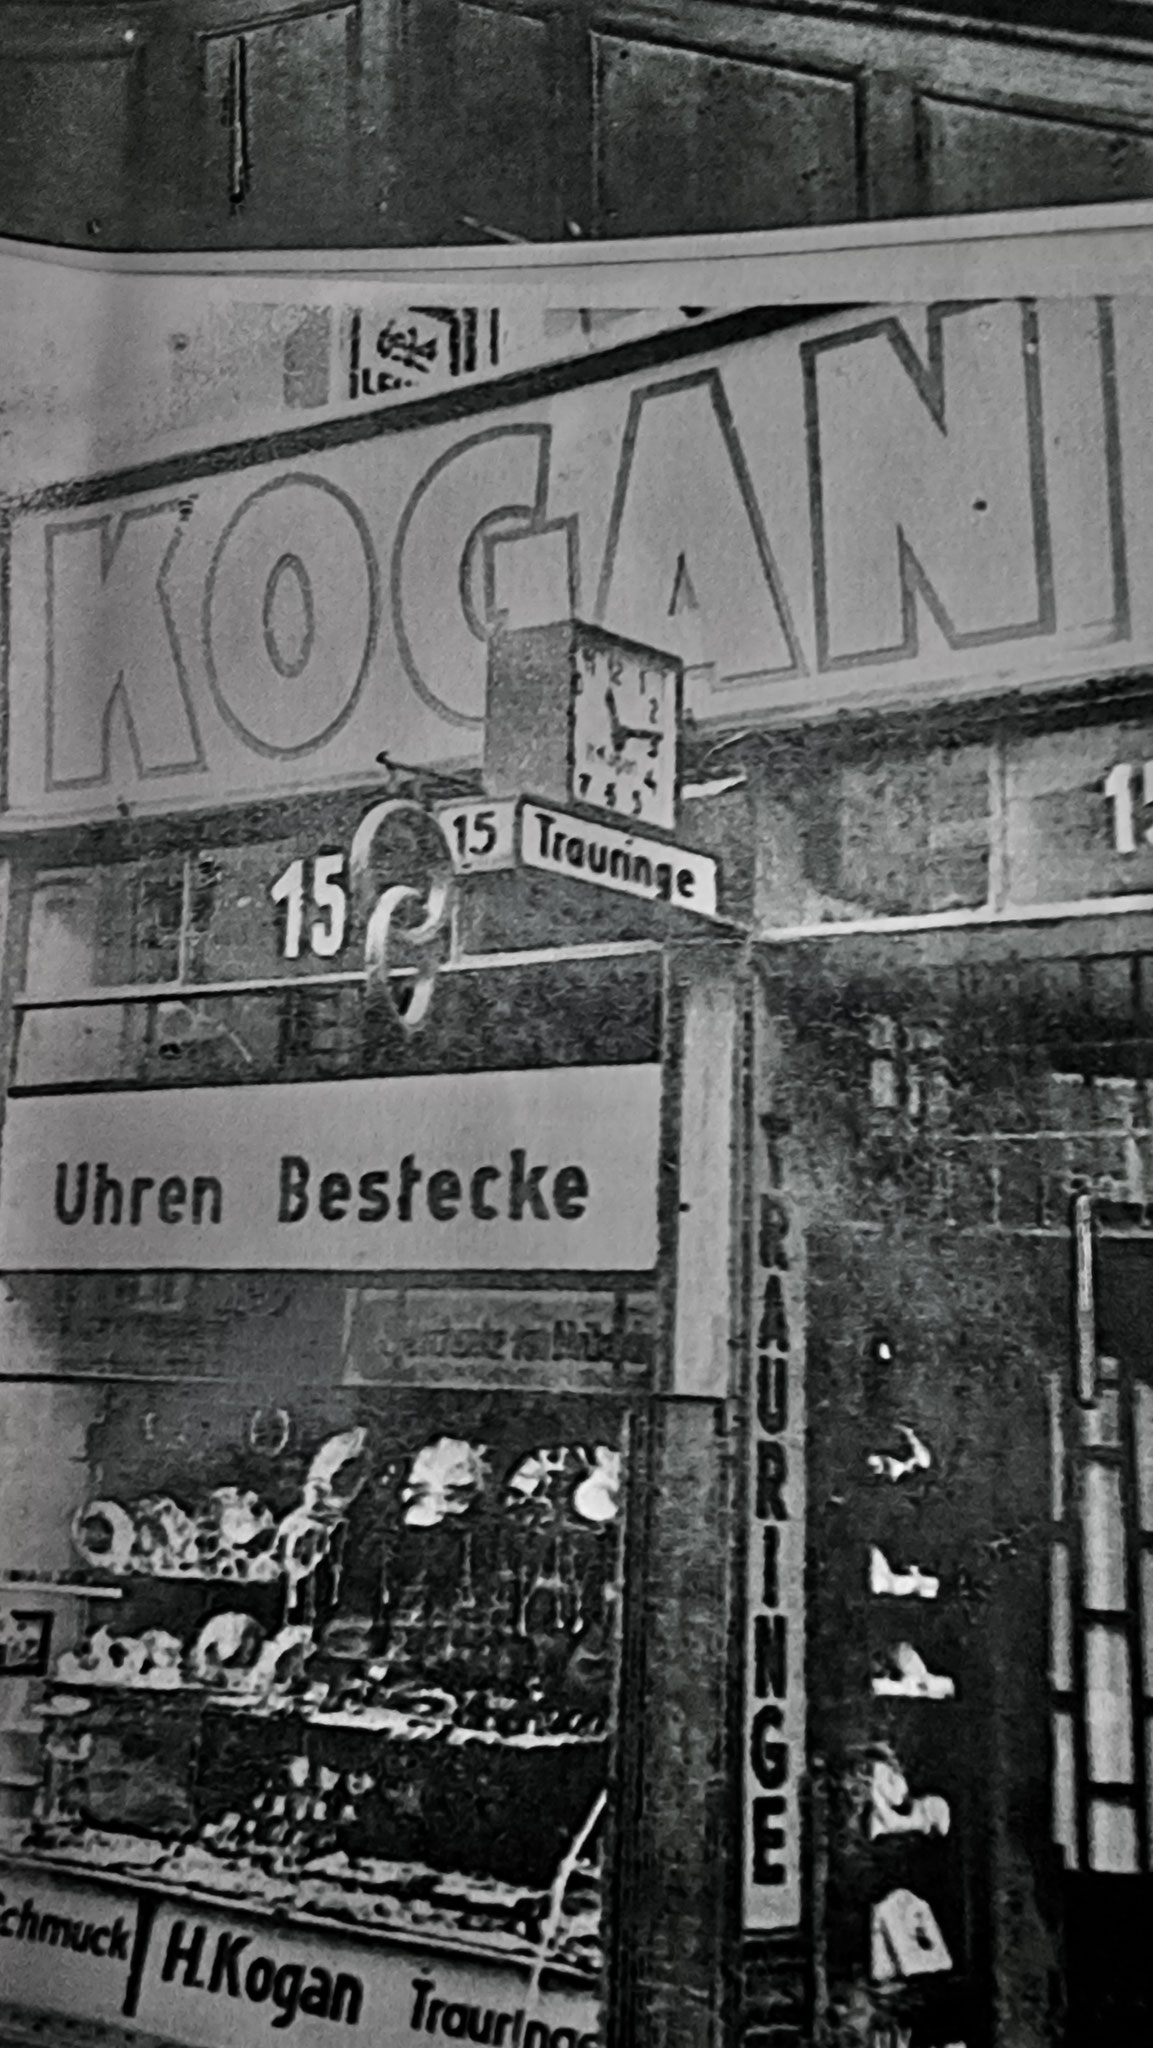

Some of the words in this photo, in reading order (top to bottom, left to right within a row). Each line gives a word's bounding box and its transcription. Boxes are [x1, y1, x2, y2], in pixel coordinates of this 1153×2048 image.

[44, 298, 1056, 793] KOGAN
[452, 810, 497, 857] 15
[1105, 758, 1153, 854] 1
[534, 812, 695, 902] Trauringe
[270, 853, 346, 958] 15
[55, 1161, 222, 1226] Uhren
[278, 1148, 589, 1222] Bestecke
[751, 1113, 792, 1885] TRAURINGE
[0, 1890, 131, 1961] chmuck
